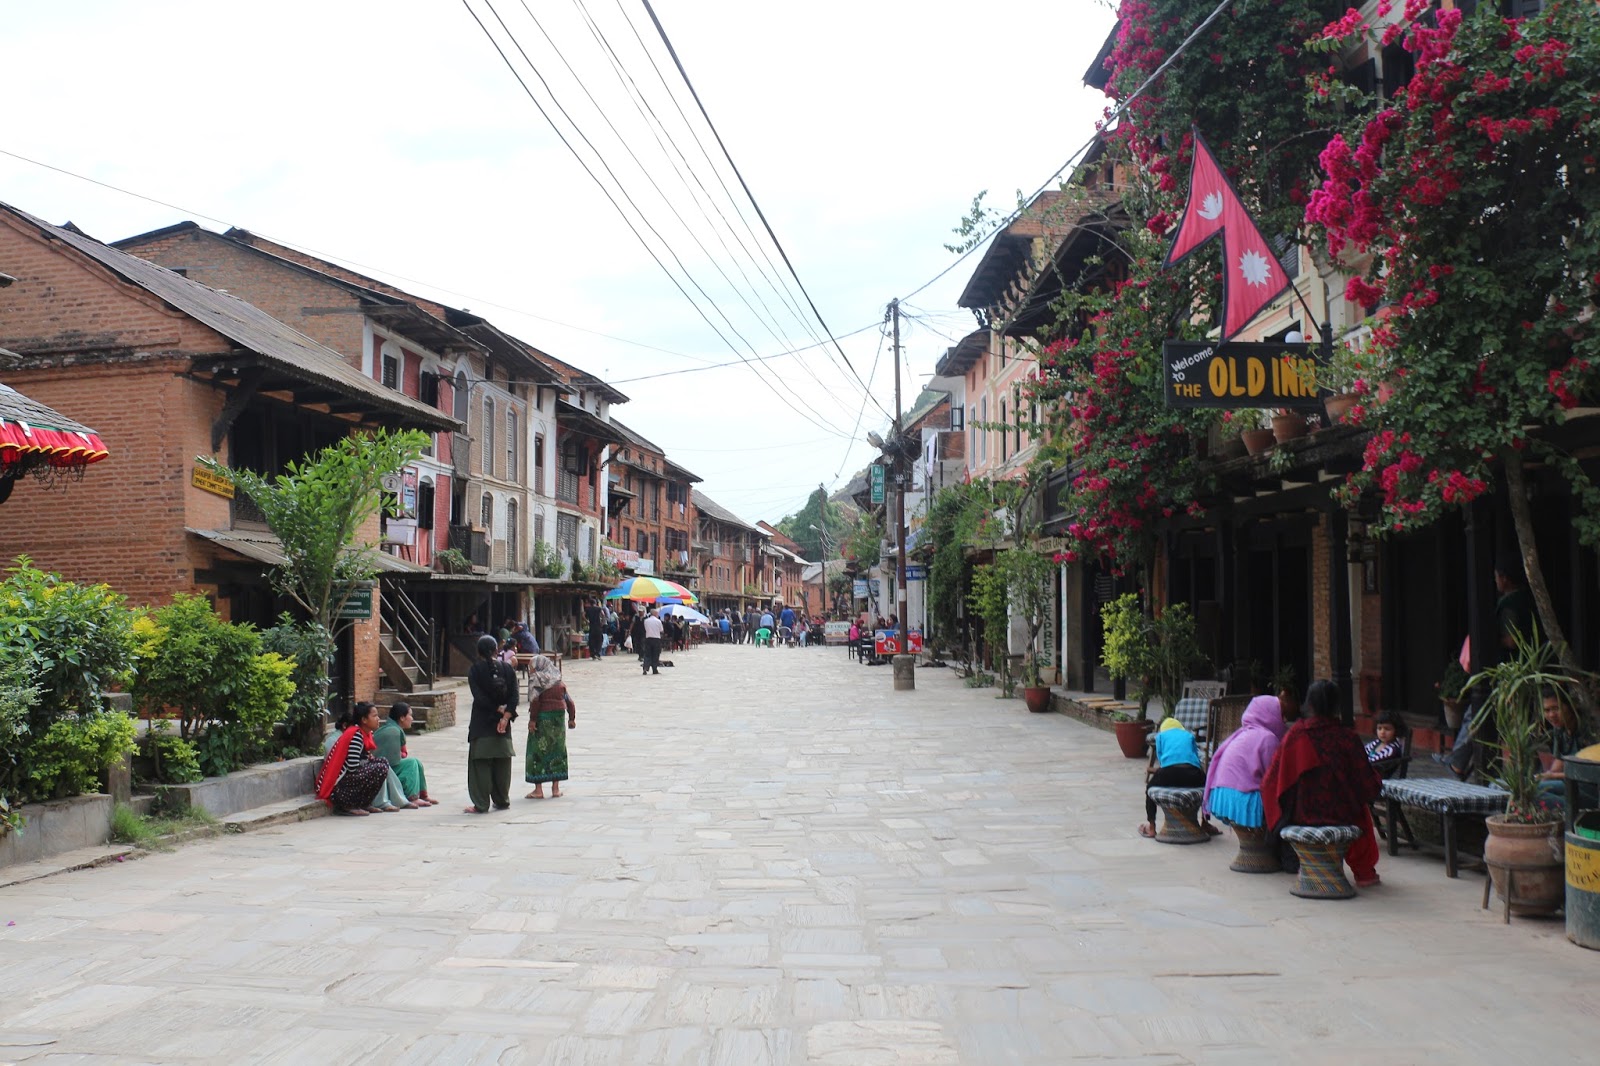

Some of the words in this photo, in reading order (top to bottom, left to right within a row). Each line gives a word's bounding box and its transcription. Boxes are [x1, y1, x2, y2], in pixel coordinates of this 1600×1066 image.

[1171, 347, 1213, 372] Welcome
[1172, 371, 1185, 383] to
[1173, 383, 1201, 397] THE
[1208, 356, 1266, 397] OLD
[1272, 357, 1317, 397] INN
